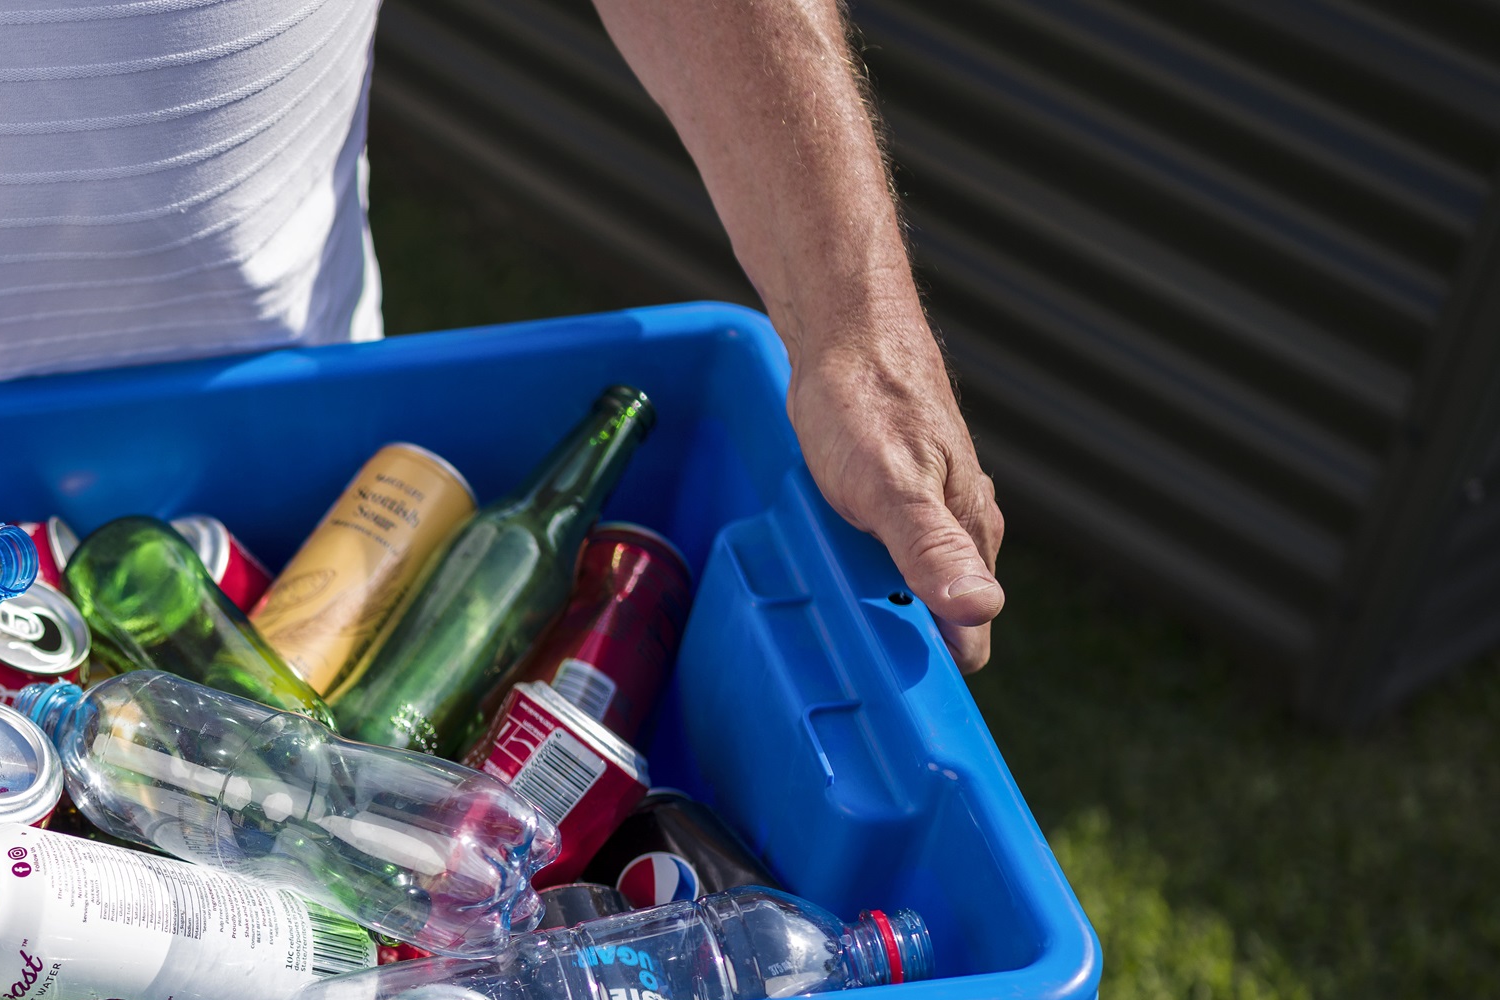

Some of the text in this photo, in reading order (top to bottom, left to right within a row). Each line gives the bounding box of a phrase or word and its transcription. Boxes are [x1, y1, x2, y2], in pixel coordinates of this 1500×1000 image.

[205, 880, 216, 910] Ingredients
[224, 885, 235, 912] Australian
[38, 962, 61, 995] WATER
